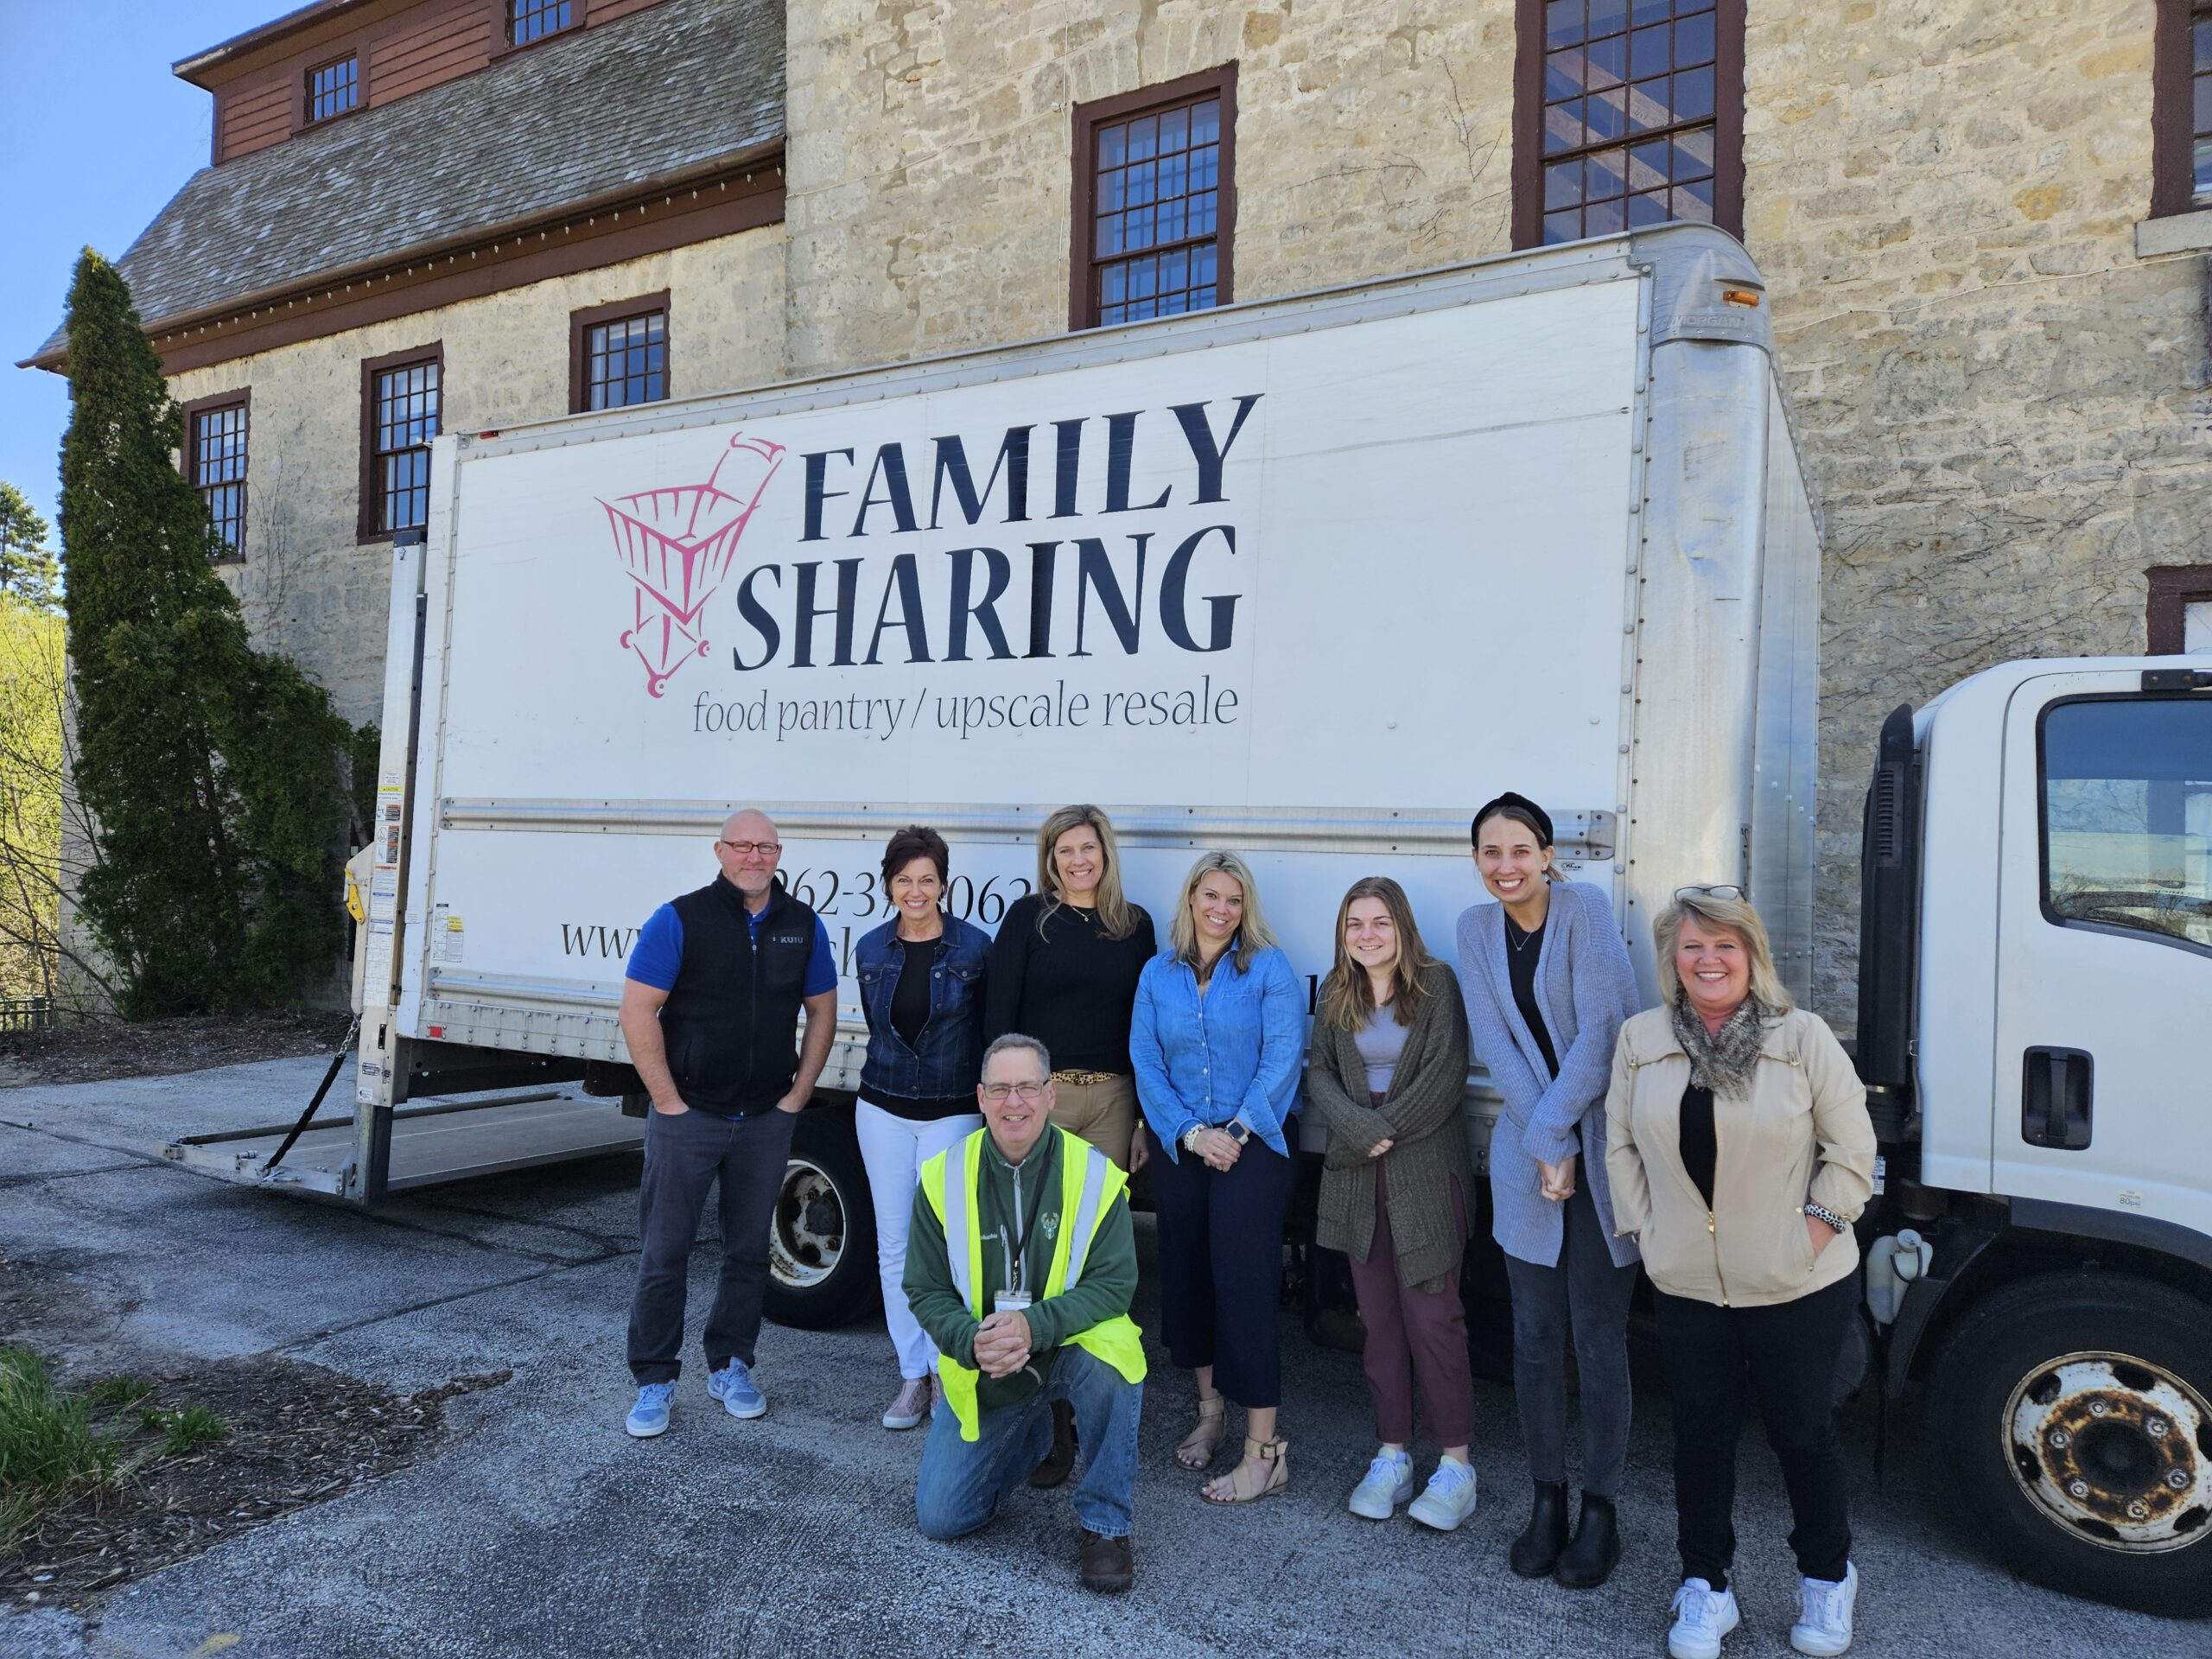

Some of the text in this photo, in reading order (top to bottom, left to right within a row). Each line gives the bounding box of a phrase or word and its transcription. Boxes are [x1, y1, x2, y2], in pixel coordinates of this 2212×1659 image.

[1670, 315, 1742, 328] MORGAN
[798, 393, 1265, 543] FAMILY
[733, 524, 1243, 671] SHARING
[693, 689, 767, 733] food
[936, 679, 1090, 740] upscale
[1103, 674, 1238, 727] resale
[780, 936, 804, 944] KUIU
